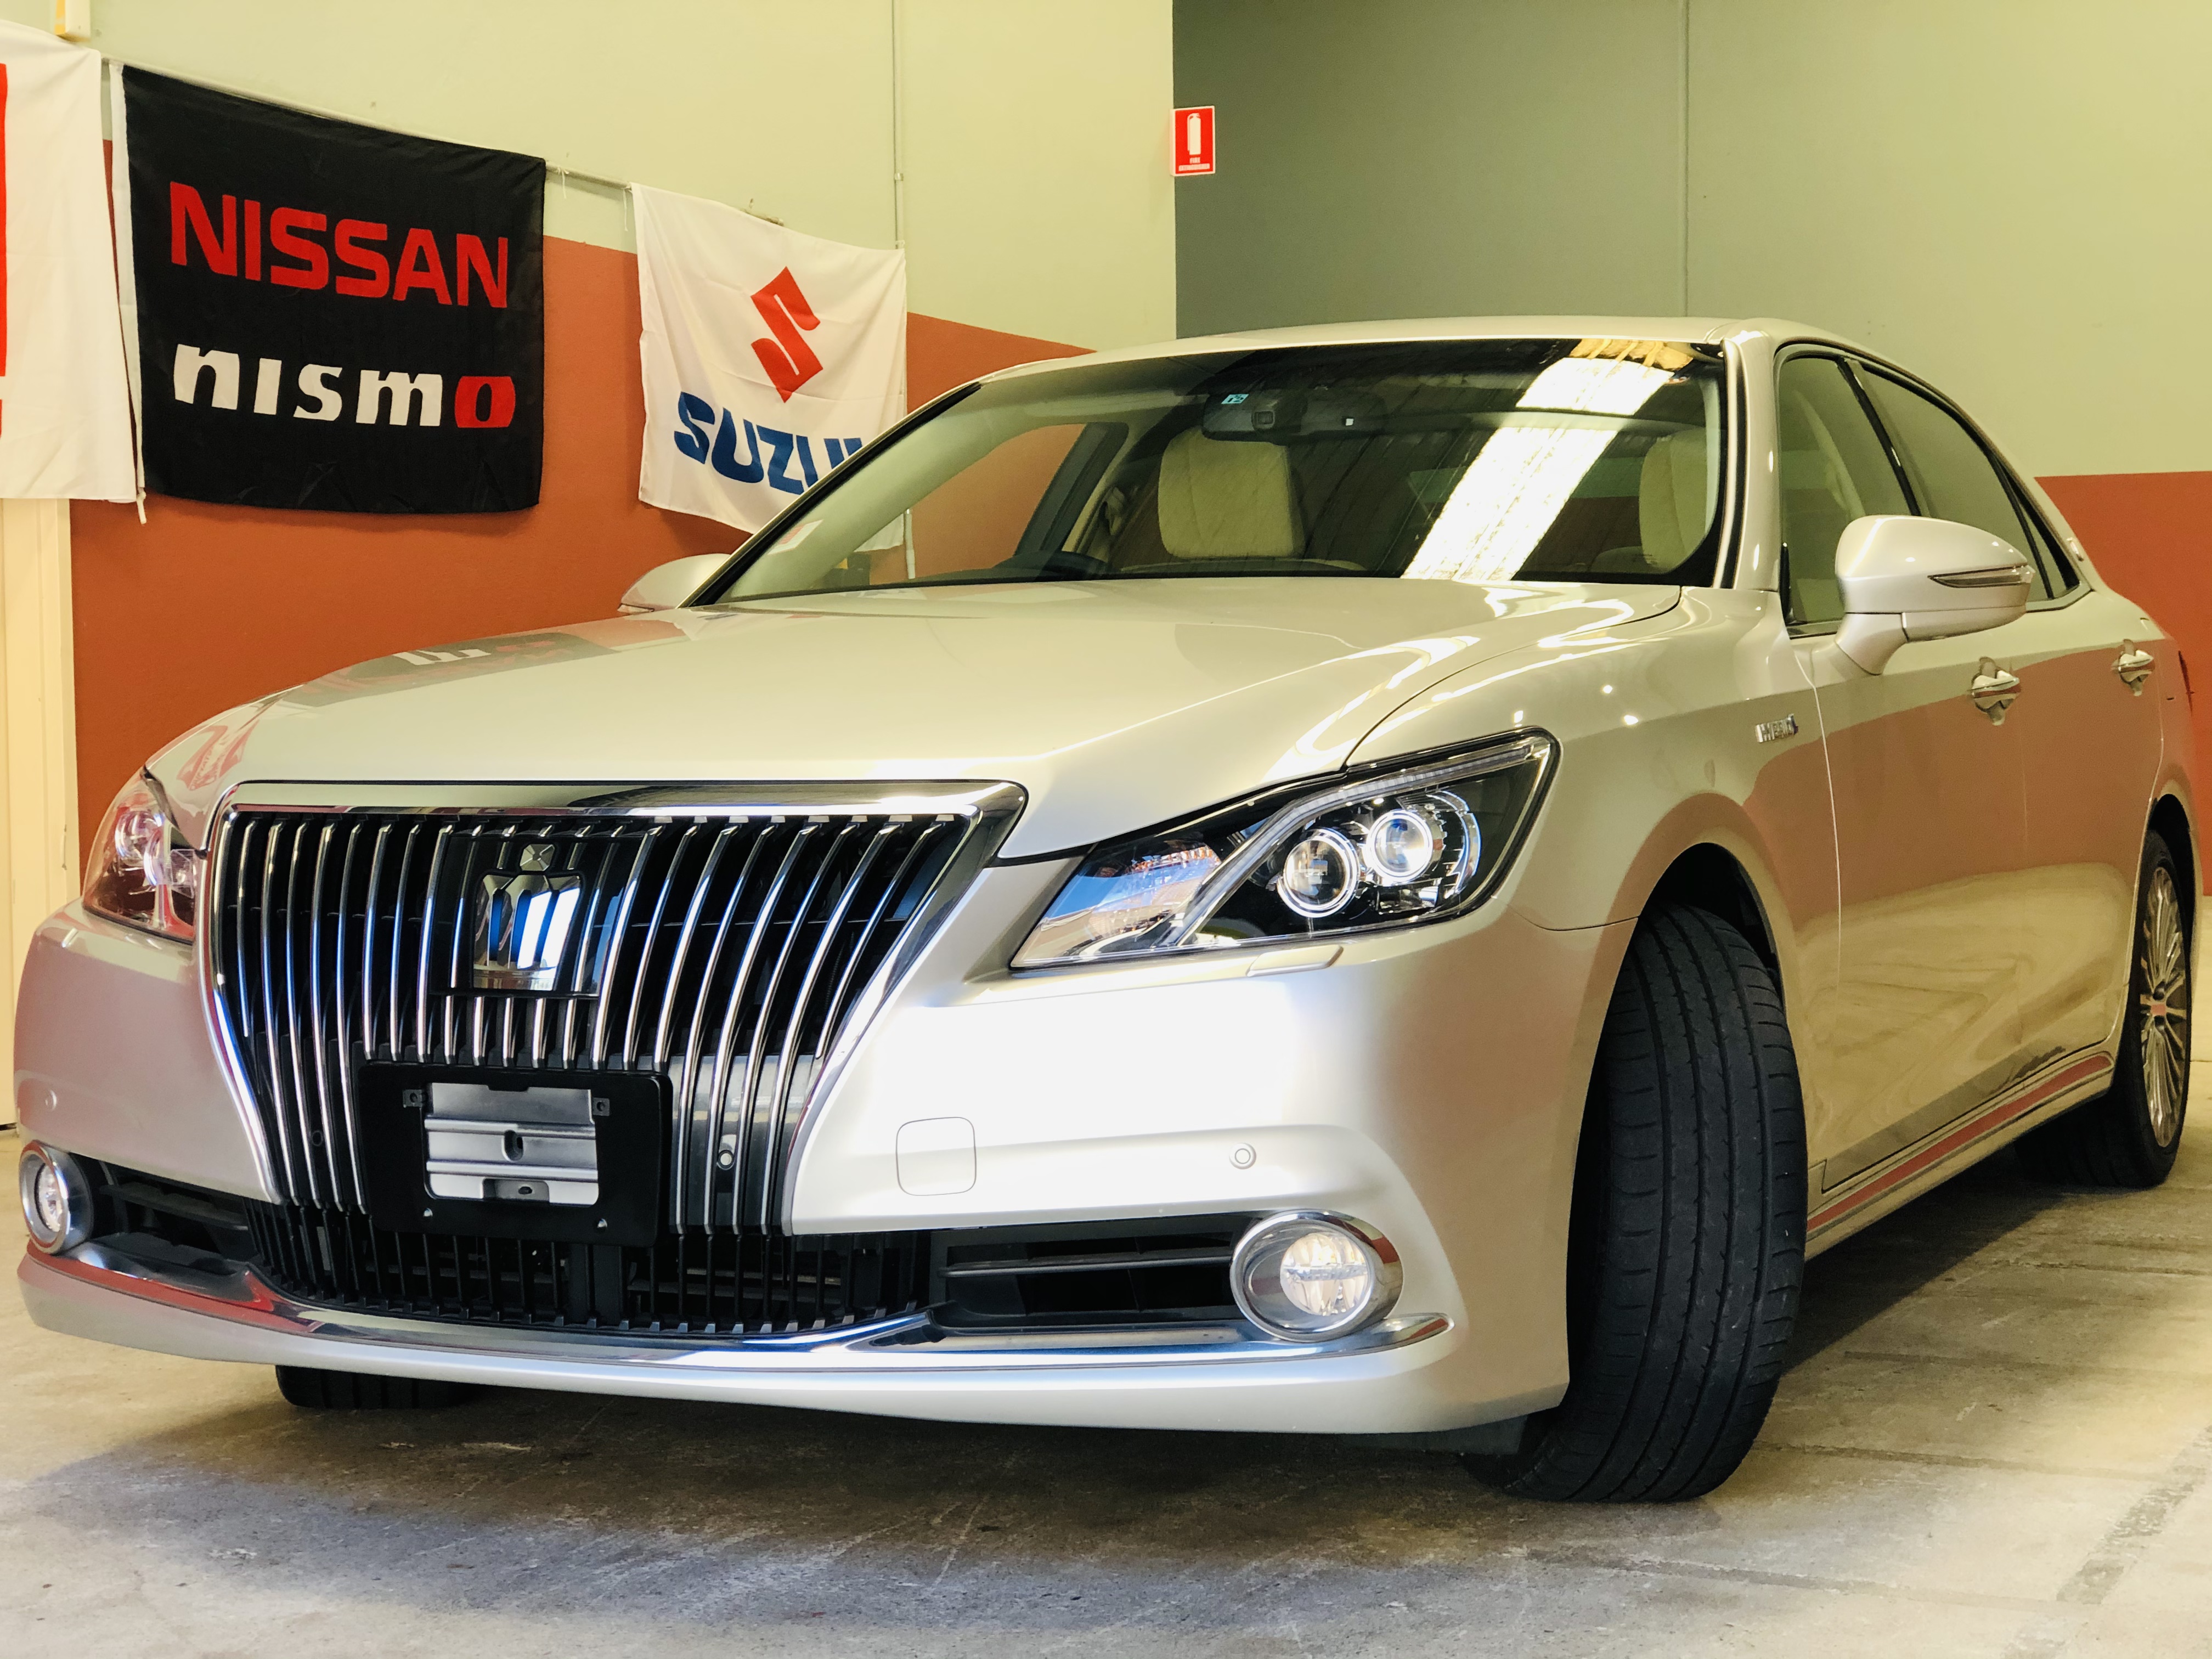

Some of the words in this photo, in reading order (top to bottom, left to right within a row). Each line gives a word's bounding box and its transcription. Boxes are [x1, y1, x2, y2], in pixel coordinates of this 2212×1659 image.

[170, 182, 508, 308] NISSAN
[173, 344, 516, 428] nismo
[674, 392, 862, 495] SUZU
